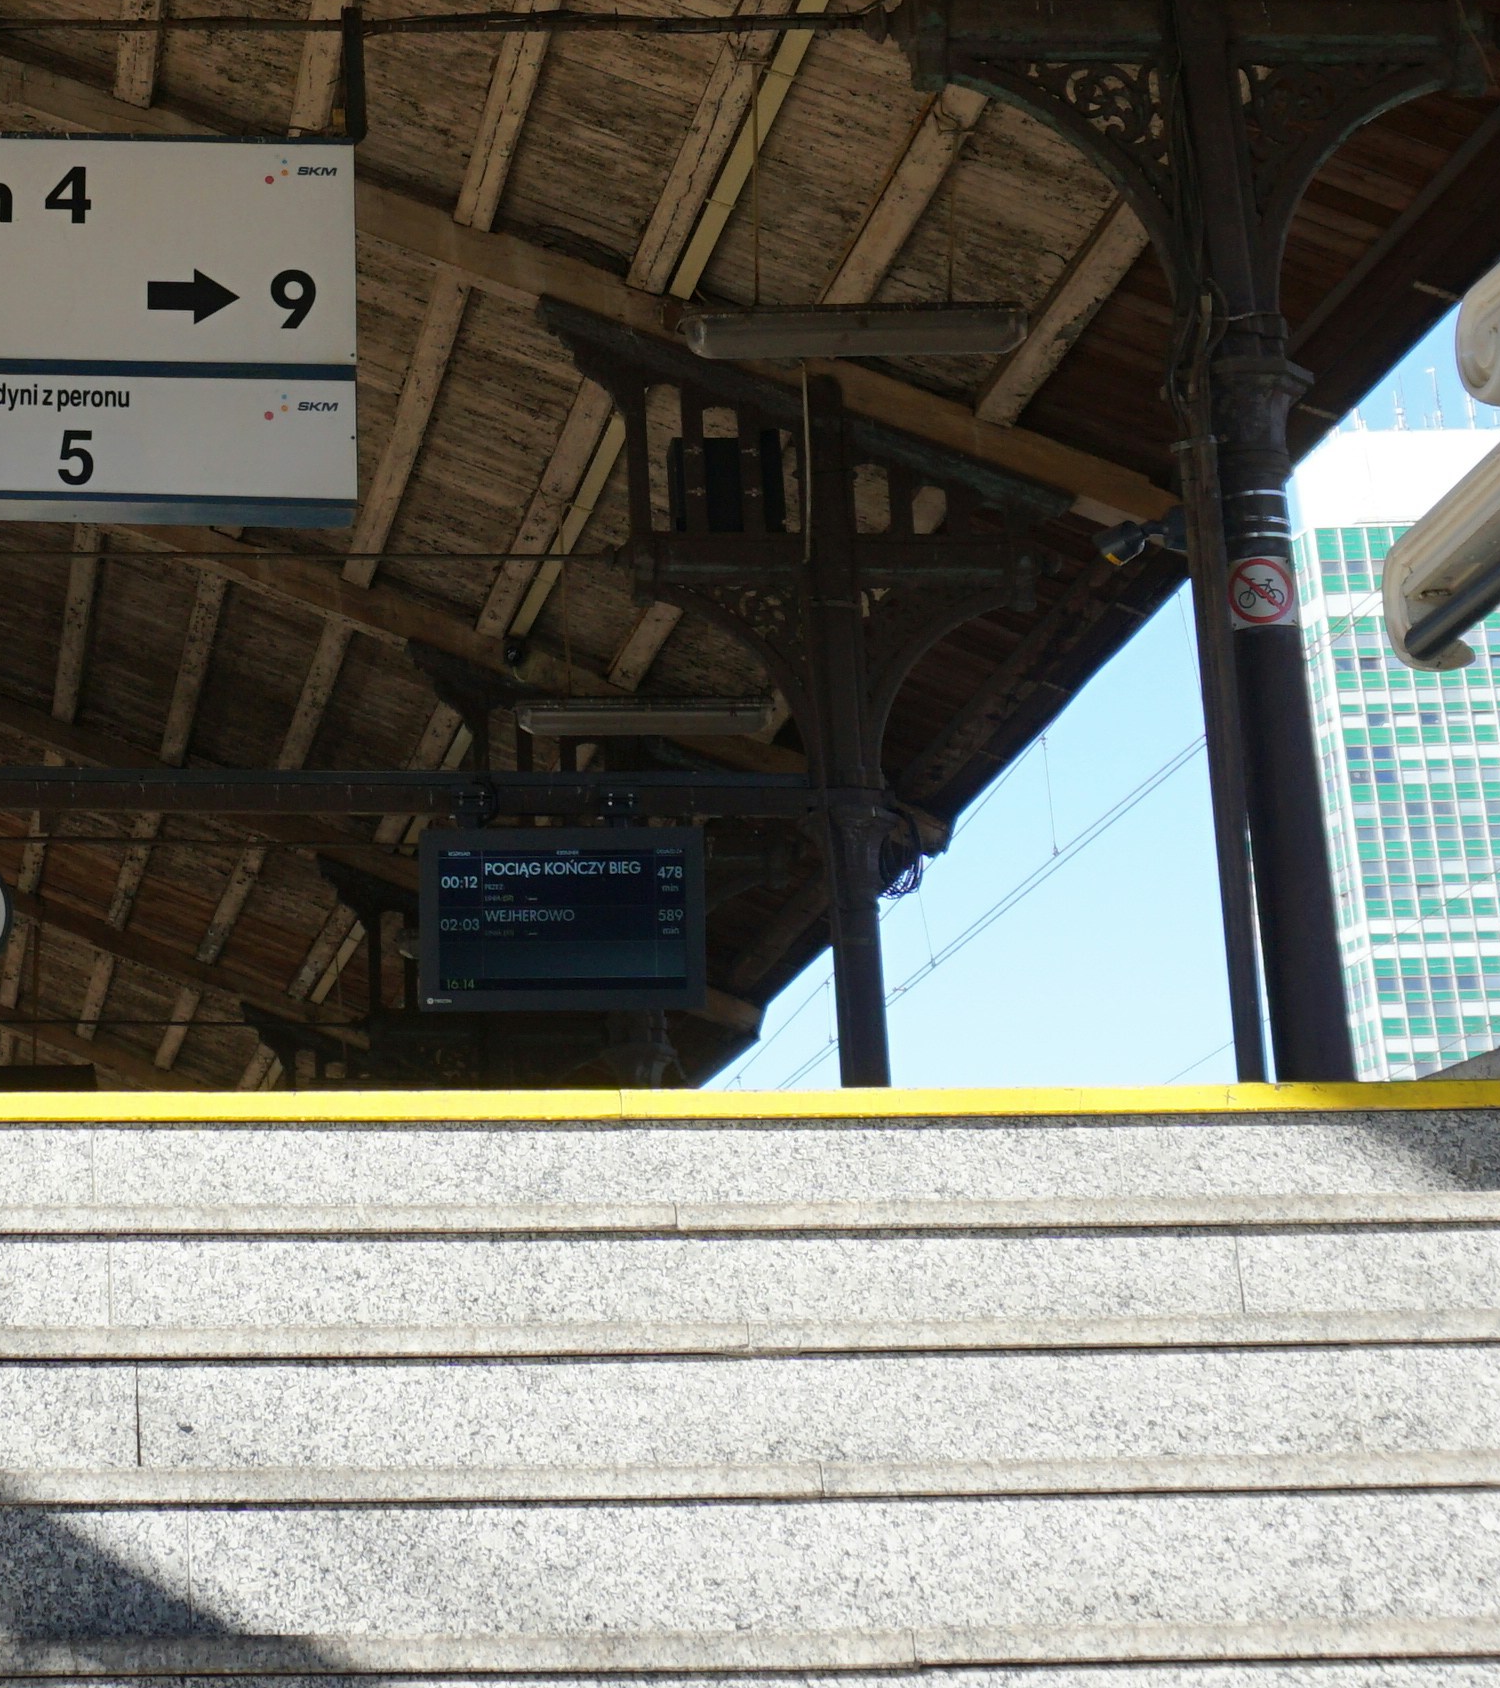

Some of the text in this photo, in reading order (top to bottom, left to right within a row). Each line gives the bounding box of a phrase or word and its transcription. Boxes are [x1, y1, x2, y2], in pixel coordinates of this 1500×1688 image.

[297, 166, 338, 177] SKM
[44, 166, 92, 224] 4
[270, 269, 317, 330] 9
[43, 390, 52, 405] z
[58, 389, 130, 410] peronu
[298, 401, 339, 412] SKM
[57, 429, 94, 486] 5
[484, 859, 641, 878] POCIĄG KOŃCZY BIEG
[657, 866, 683, 879] 478
[441, 875, 478, 889] 00:12
[662, 883, 679, 892] min
[485, 909, 575, 922] WEJHEROWO
[658, 909, 683, 922] 589
[440, 918, 480, 931] 02:03
[662, 926, 680, 935] min
